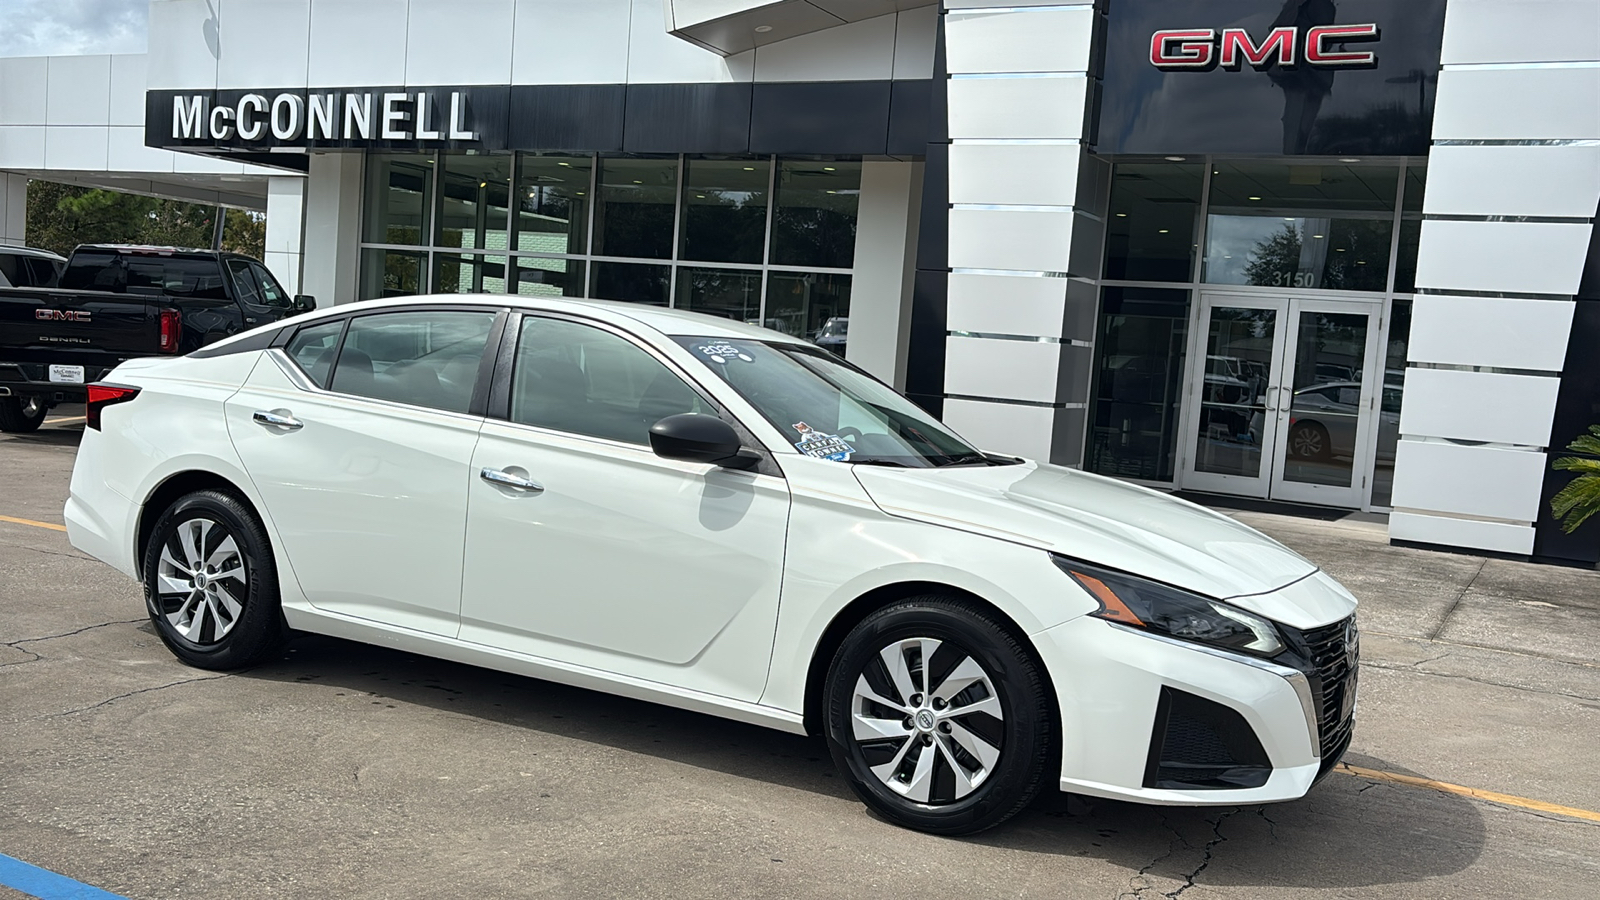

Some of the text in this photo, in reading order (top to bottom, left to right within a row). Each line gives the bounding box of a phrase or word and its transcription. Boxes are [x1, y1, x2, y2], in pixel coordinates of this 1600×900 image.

[1149, 23, 1378, 68] GMC
[172, 92, 478, 140] McCONNELL
[1271, 270, 1315, 288] 3150
[36, 309, 91, 321] GMC
[698, 345, 739, 354] 2025
